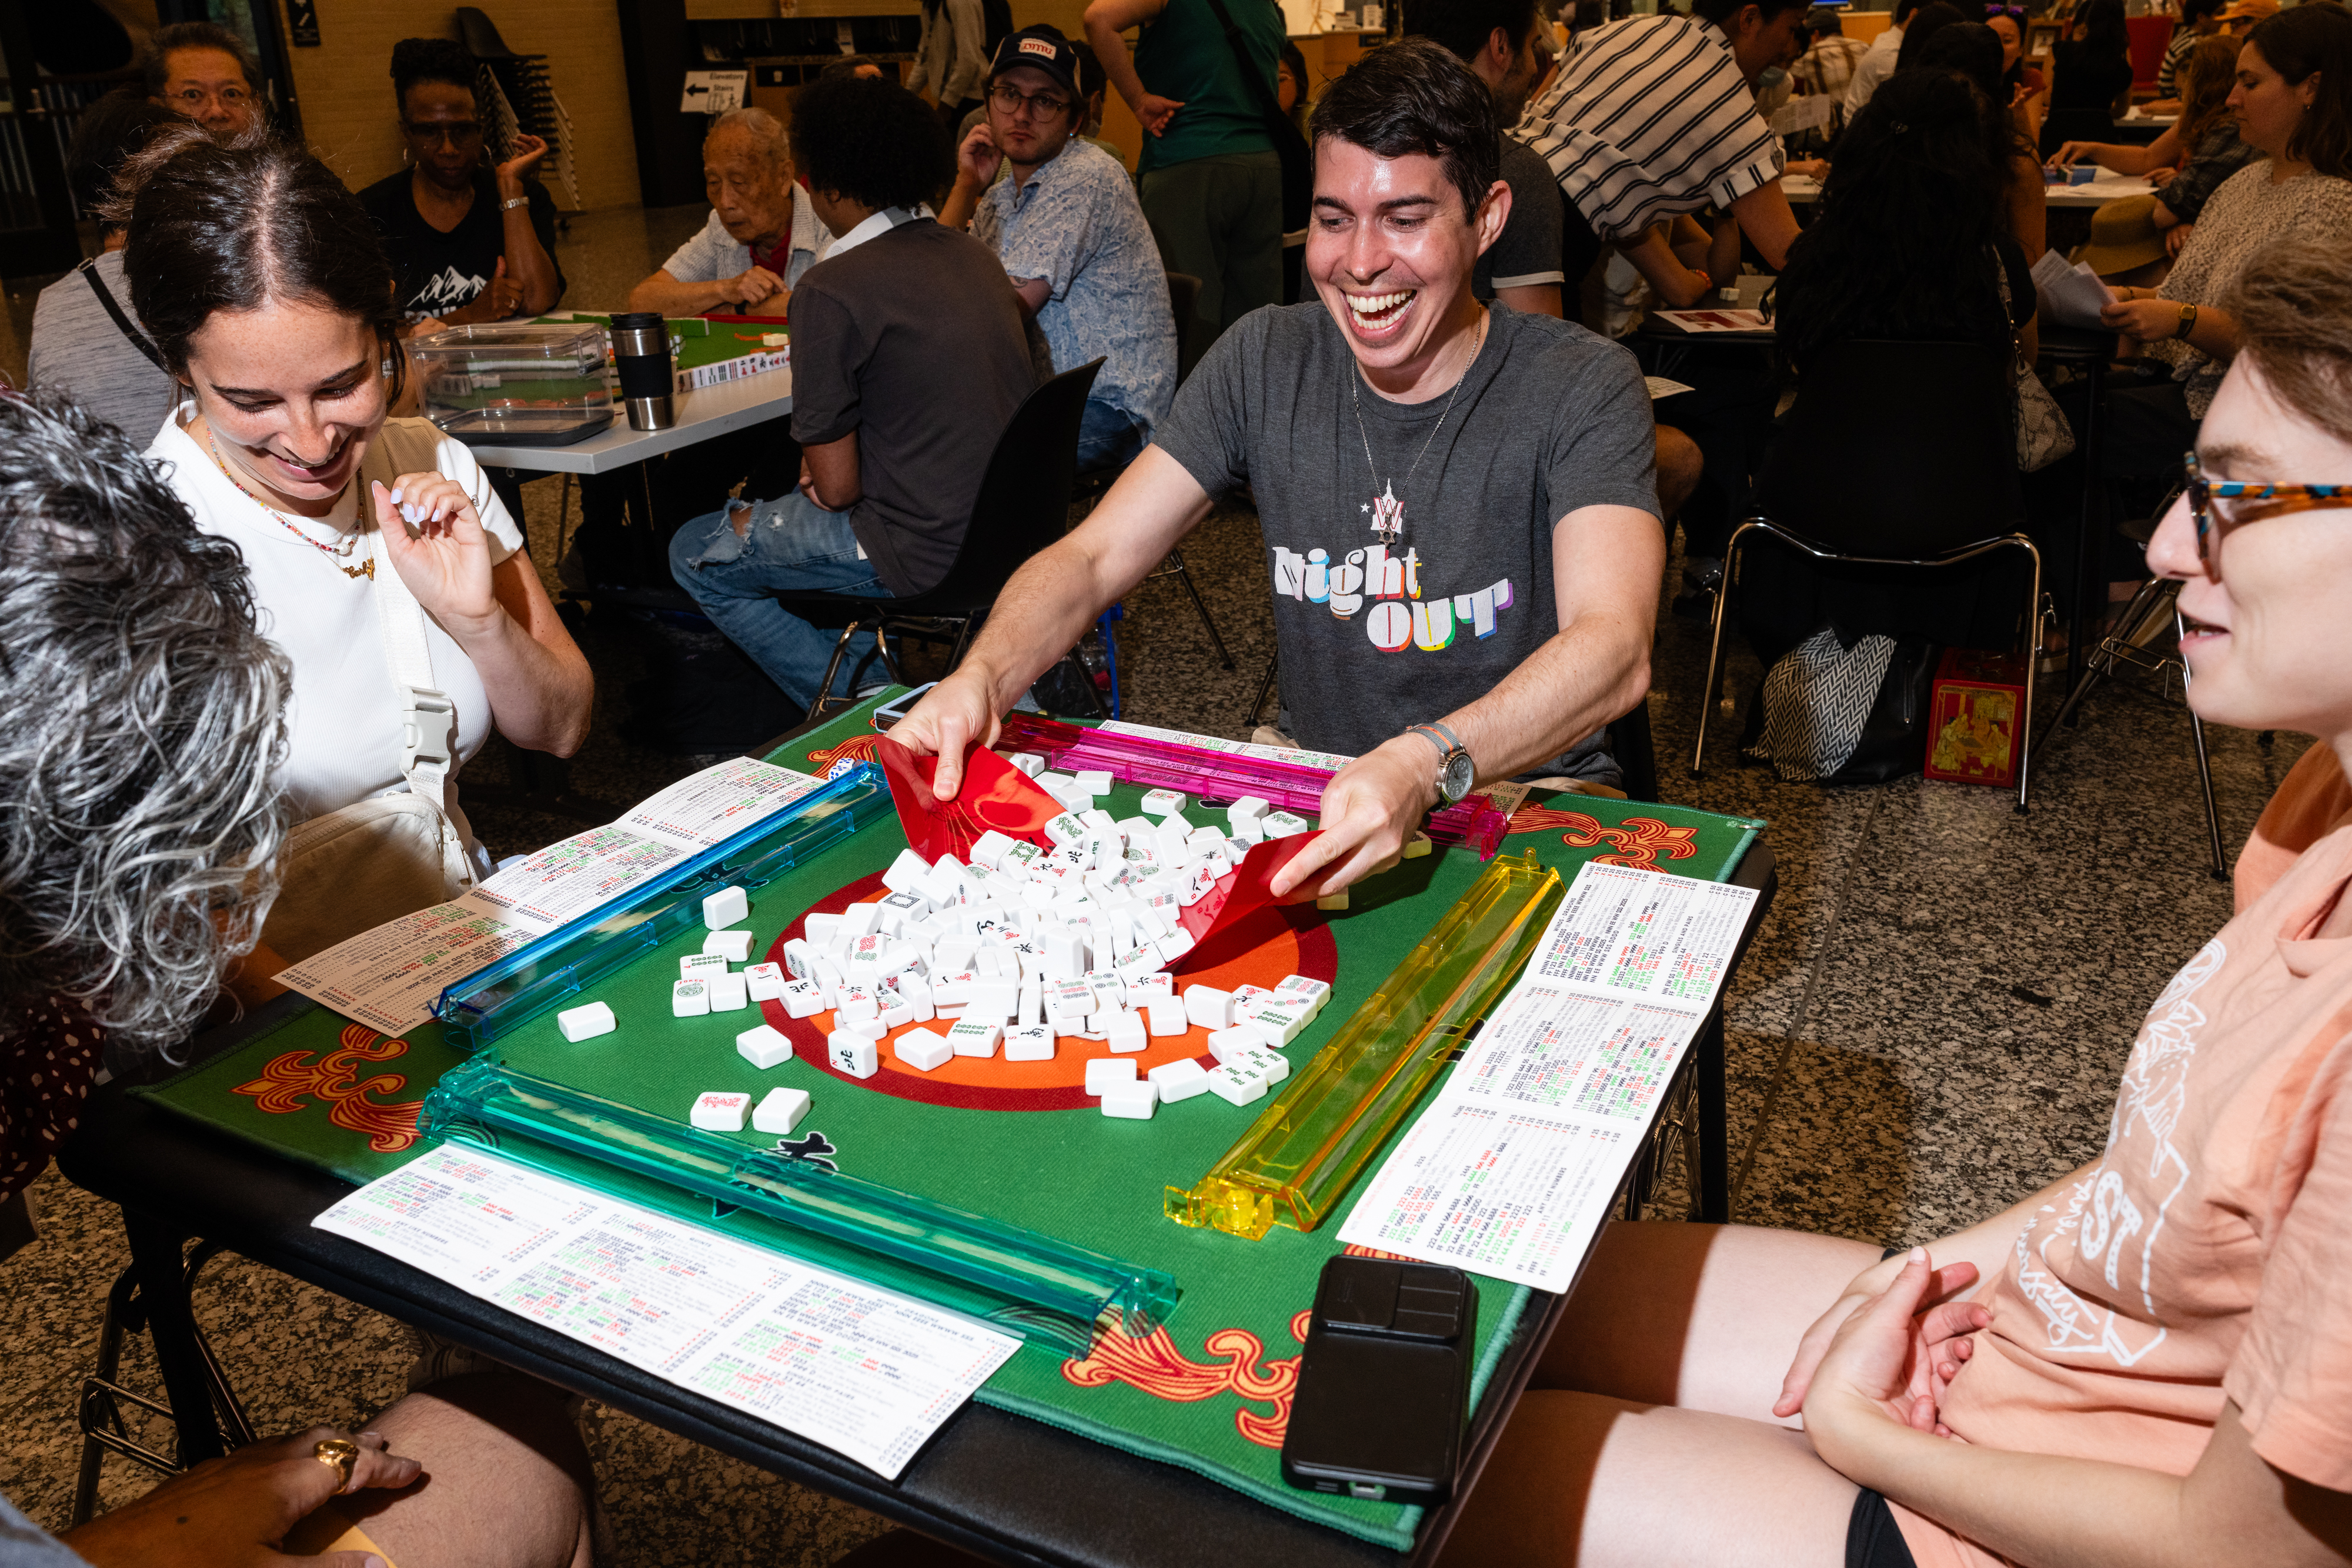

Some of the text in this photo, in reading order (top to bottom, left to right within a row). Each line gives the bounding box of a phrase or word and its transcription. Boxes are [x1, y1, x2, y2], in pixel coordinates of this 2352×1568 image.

[1373, 497, 1405, 530] W
[1272, 544, 1422, 620] Night
[1367, 578, 1514, 653] OUT
[1068, 851, 1083, 863] 北
[1142, 848, 1152, 861] JOKER
[572, 865, 587, 874] 13579
[977, 862, 994, 872] JOKE
[1584, 865, 1595, 878] VALUES
[610, 873, 644, 891] CONSECUTIVE
[1575, 891, 1588, 905] WWWW
[1562, 898, 1576, 916] DRAGONS
[1571, 905, 1580, 914] EEEE
[1565, 914, 1575, 923] NNN
[1605, 925, 1613, 934] NNN
[1619, 898, 1628, 907] 2025
[1553, 919, 1564, 931] WINDS
[402, 934, 428, 945] SINGLES
[1672, 937, 1683, 953] SINGLES
[1683, 915, 1693, 927] PAIRS
[1548, 961, 1557, 969] 123
[1556, 944, 1566, 954] DDD
[1561, 932, 1572, 944] DDDD
[1563, 941, 1575, 954] WWW
[1571, 931, 1580, 941] SSSS
[1588, 935, 1601, 951] WWWW
[369, 951, 388, 961] PAIRS
[1539, 960, 1550, 974] NNNN
[1550, 938, 1561, 951] WWW
[1557, 928, 1567, 938] SSSS
[1560, 936, 1585, 978] FFFF DDD NEWS DDD
[1567, 965, 1578, 979] NNNN
[1583, 937, 1592, 947] SSSS
[1584, 952, 1593, 960] 222
[1588, 954, 1599, 966] WWW
[1597, 939, 1607, 949] 2025
[1589, 975, 1598, 983] NN
[1596, 953, 1608, 967] WWW
[1603, 944, 1612, 952] SSS
[1608, 930, 1619, 943] DDDD
[1574, 971, 1583, 980] EEEE
[1671, 979, 1681, 990] 2468
[1679, 959, 1689, 971] 2468
[1676, 980, 1688, 997] 336699
[1683, 964, 1695, 980] 336699
[789, 982, 809, 992] 北
[1525, 987, 1538, 998] VALUES
[392, 1018, 418, 1032] VALUES
[1494, 1024, 1508, 1038] QUINTS
[1521, 1028, 1542, 1054] CONSECUTIVE
[1596, 1041, 1608, 1052] 13579
[840, 1049, 855, 1071] 北
